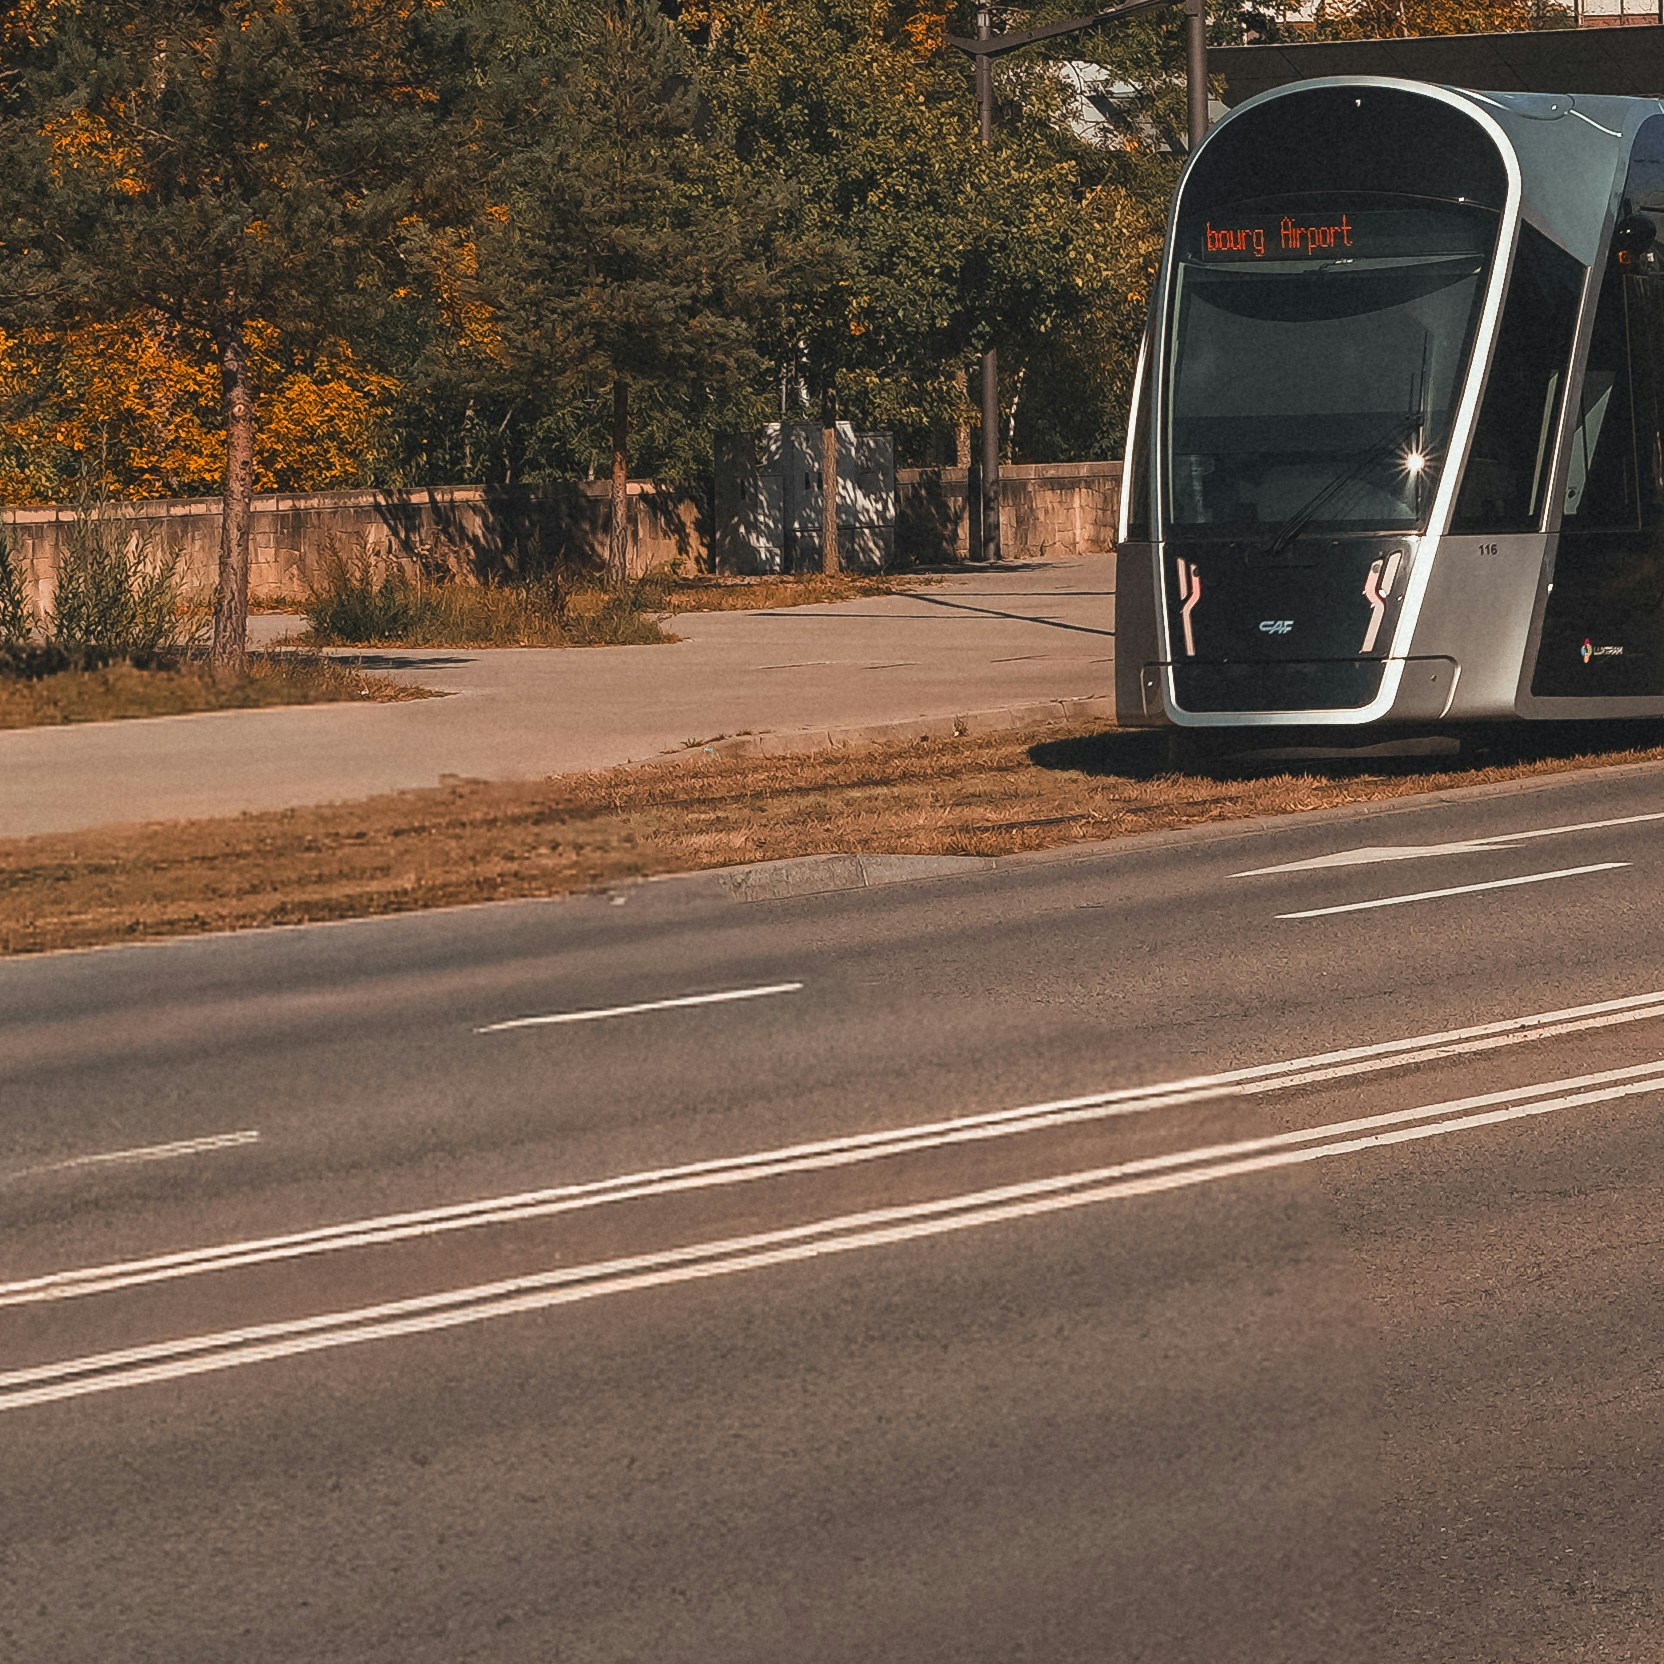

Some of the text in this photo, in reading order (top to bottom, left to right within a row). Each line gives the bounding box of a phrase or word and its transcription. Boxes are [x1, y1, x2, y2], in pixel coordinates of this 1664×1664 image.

[1206, 213, 1354, 257] bourg Airport
[1478, 544, 1498, 556] 116
[1259, 620, 1294, 634] CAF
